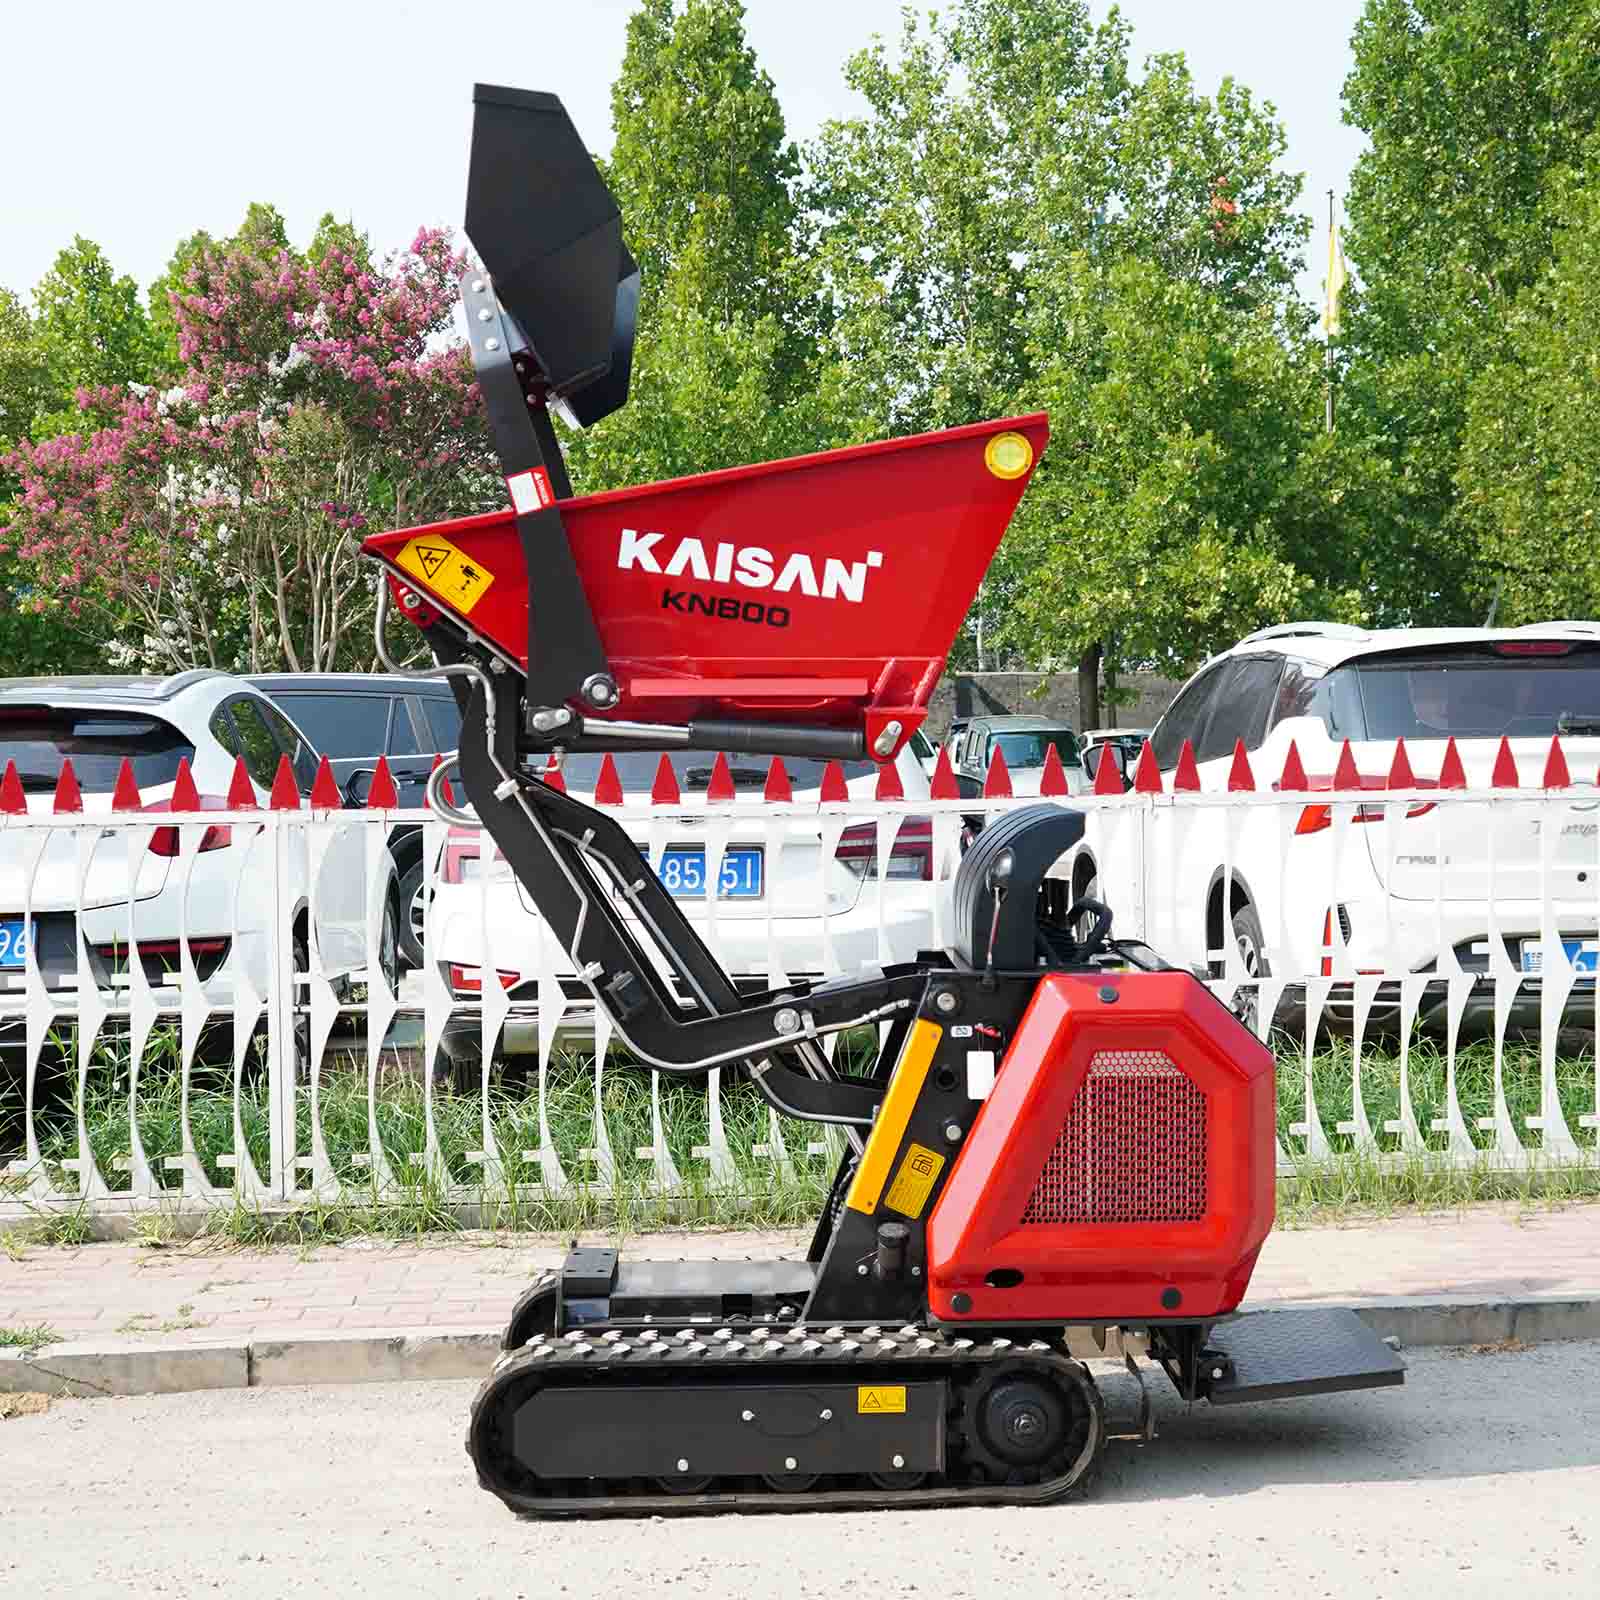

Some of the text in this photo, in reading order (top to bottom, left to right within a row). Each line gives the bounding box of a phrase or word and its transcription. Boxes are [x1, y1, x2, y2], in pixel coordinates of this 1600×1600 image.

[617, 528, 869, 603] KAISAN
[661, 588, 791, 628] KN800
[664, 858, 752, 889] 8551
